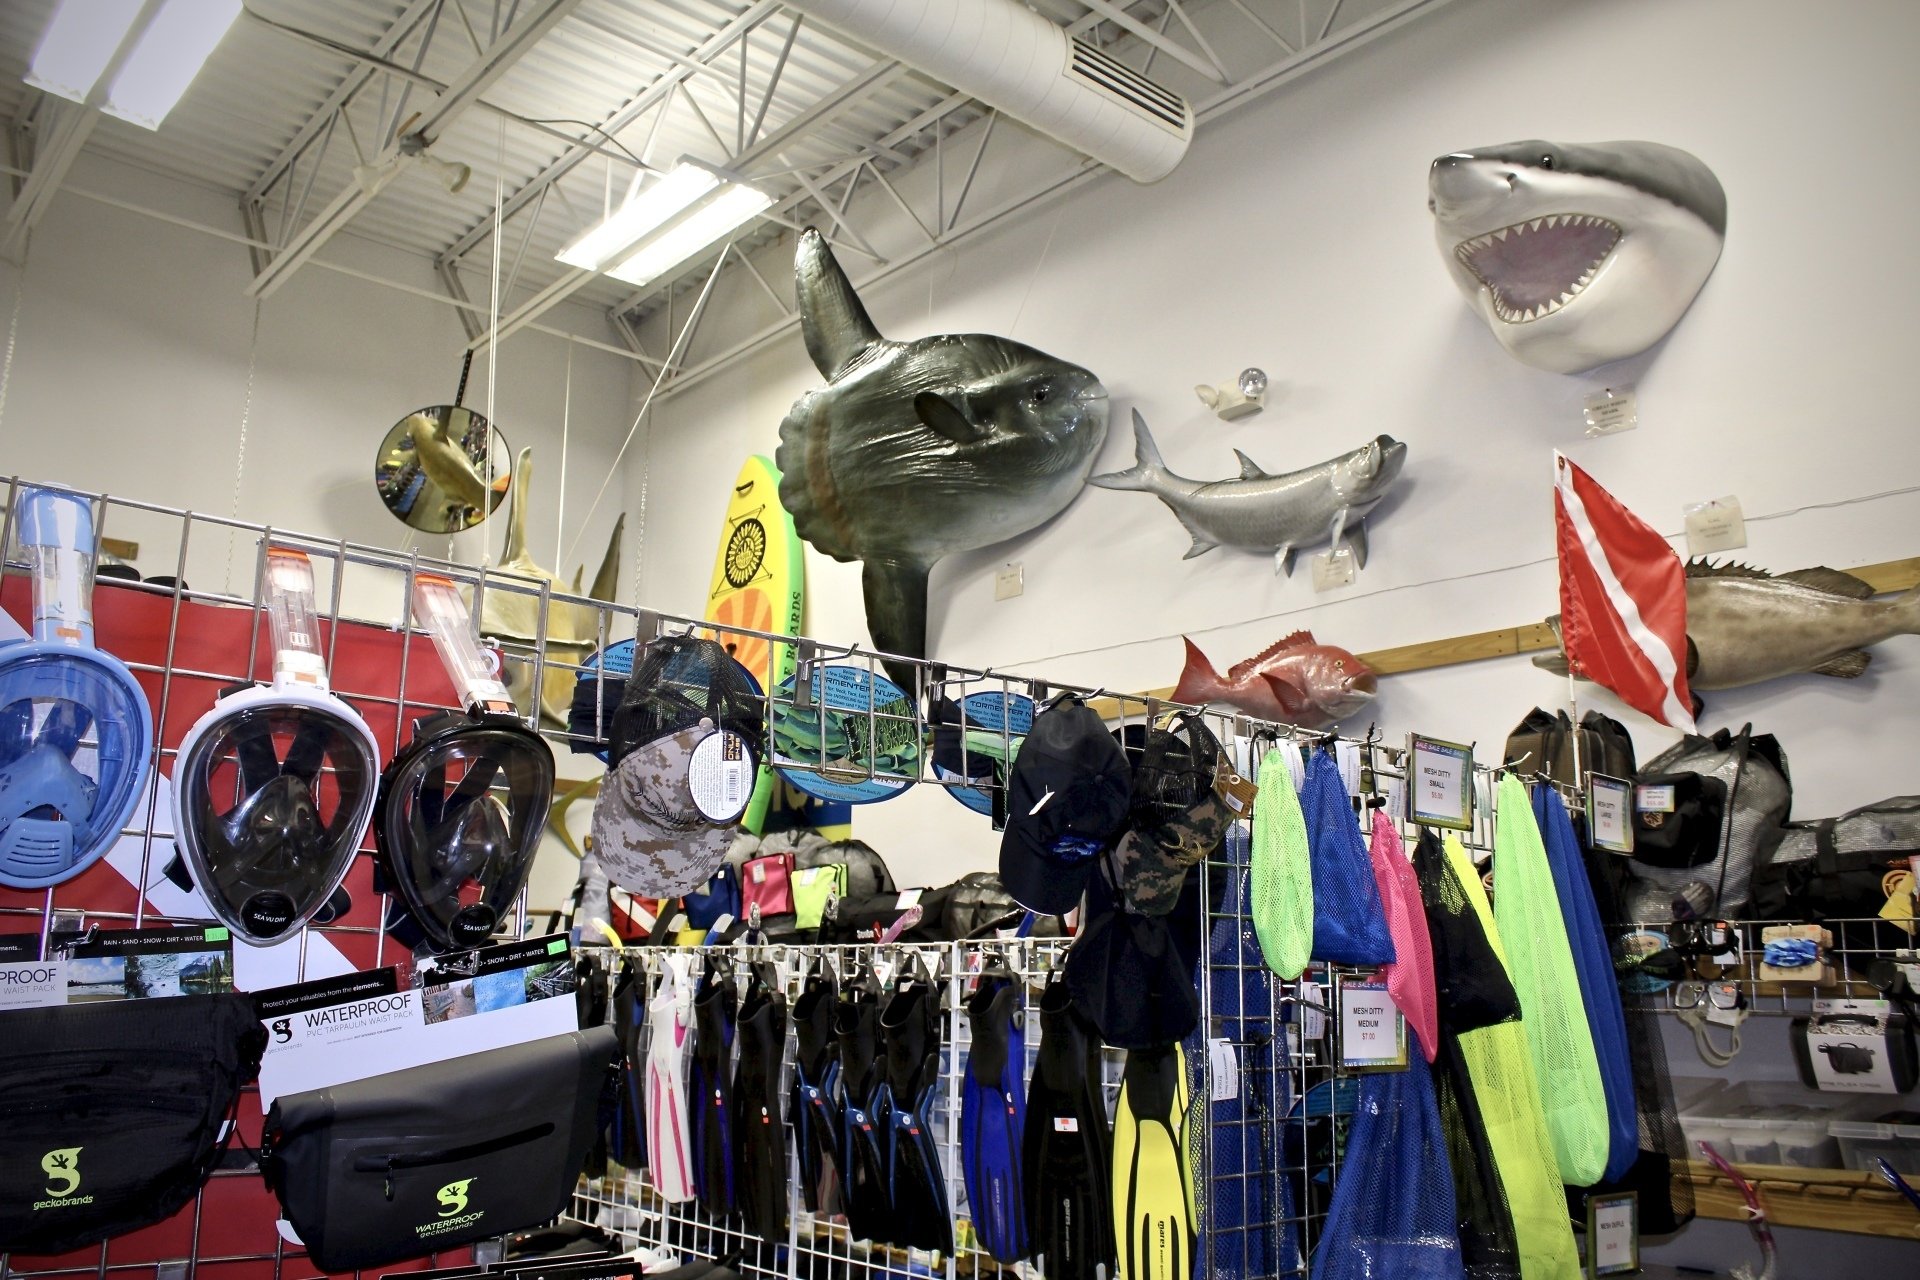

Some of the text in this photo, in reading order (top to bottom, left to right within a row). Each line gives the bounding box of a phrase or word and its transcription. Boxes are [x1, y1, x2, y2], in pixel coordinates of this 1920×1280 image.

[813, 674, 870, 692] TRMENTER
[1416, 741, 1427, 749] SALE
[1428, 744, 1440, 752] SALE
[1424, 767, 1450, 778] MESH DITTY
[1429, 780, 1444, 788] SMALL
[487, 956, 505, 966] SNOW
[509, 952, 522, 961] DIRT
[525, 948, 544, 958] WATER
[3, 984, 56, 995] WAIST PACK
[262, 1000, 284, 1008] Protect
[284, 998, 299, 1006] your
[300, 992, 327, 1002] valuables
[352, 981, 384, 992] elements...
[304, 994, 412, 1028] WATERPROOF
[306, 1010, 414, 1038] PVC TARPAULIN WAIST PACK
[1358, 1020, 1379, 1028] MEDIUM
[268, 1042, 303, 1055] geckobrands
[33, 1195, 94, 1210] geckobrands
[415, 1210, 484, 1234] WATERPROOF
[420, 1222, 474, 1238] geckobrands
